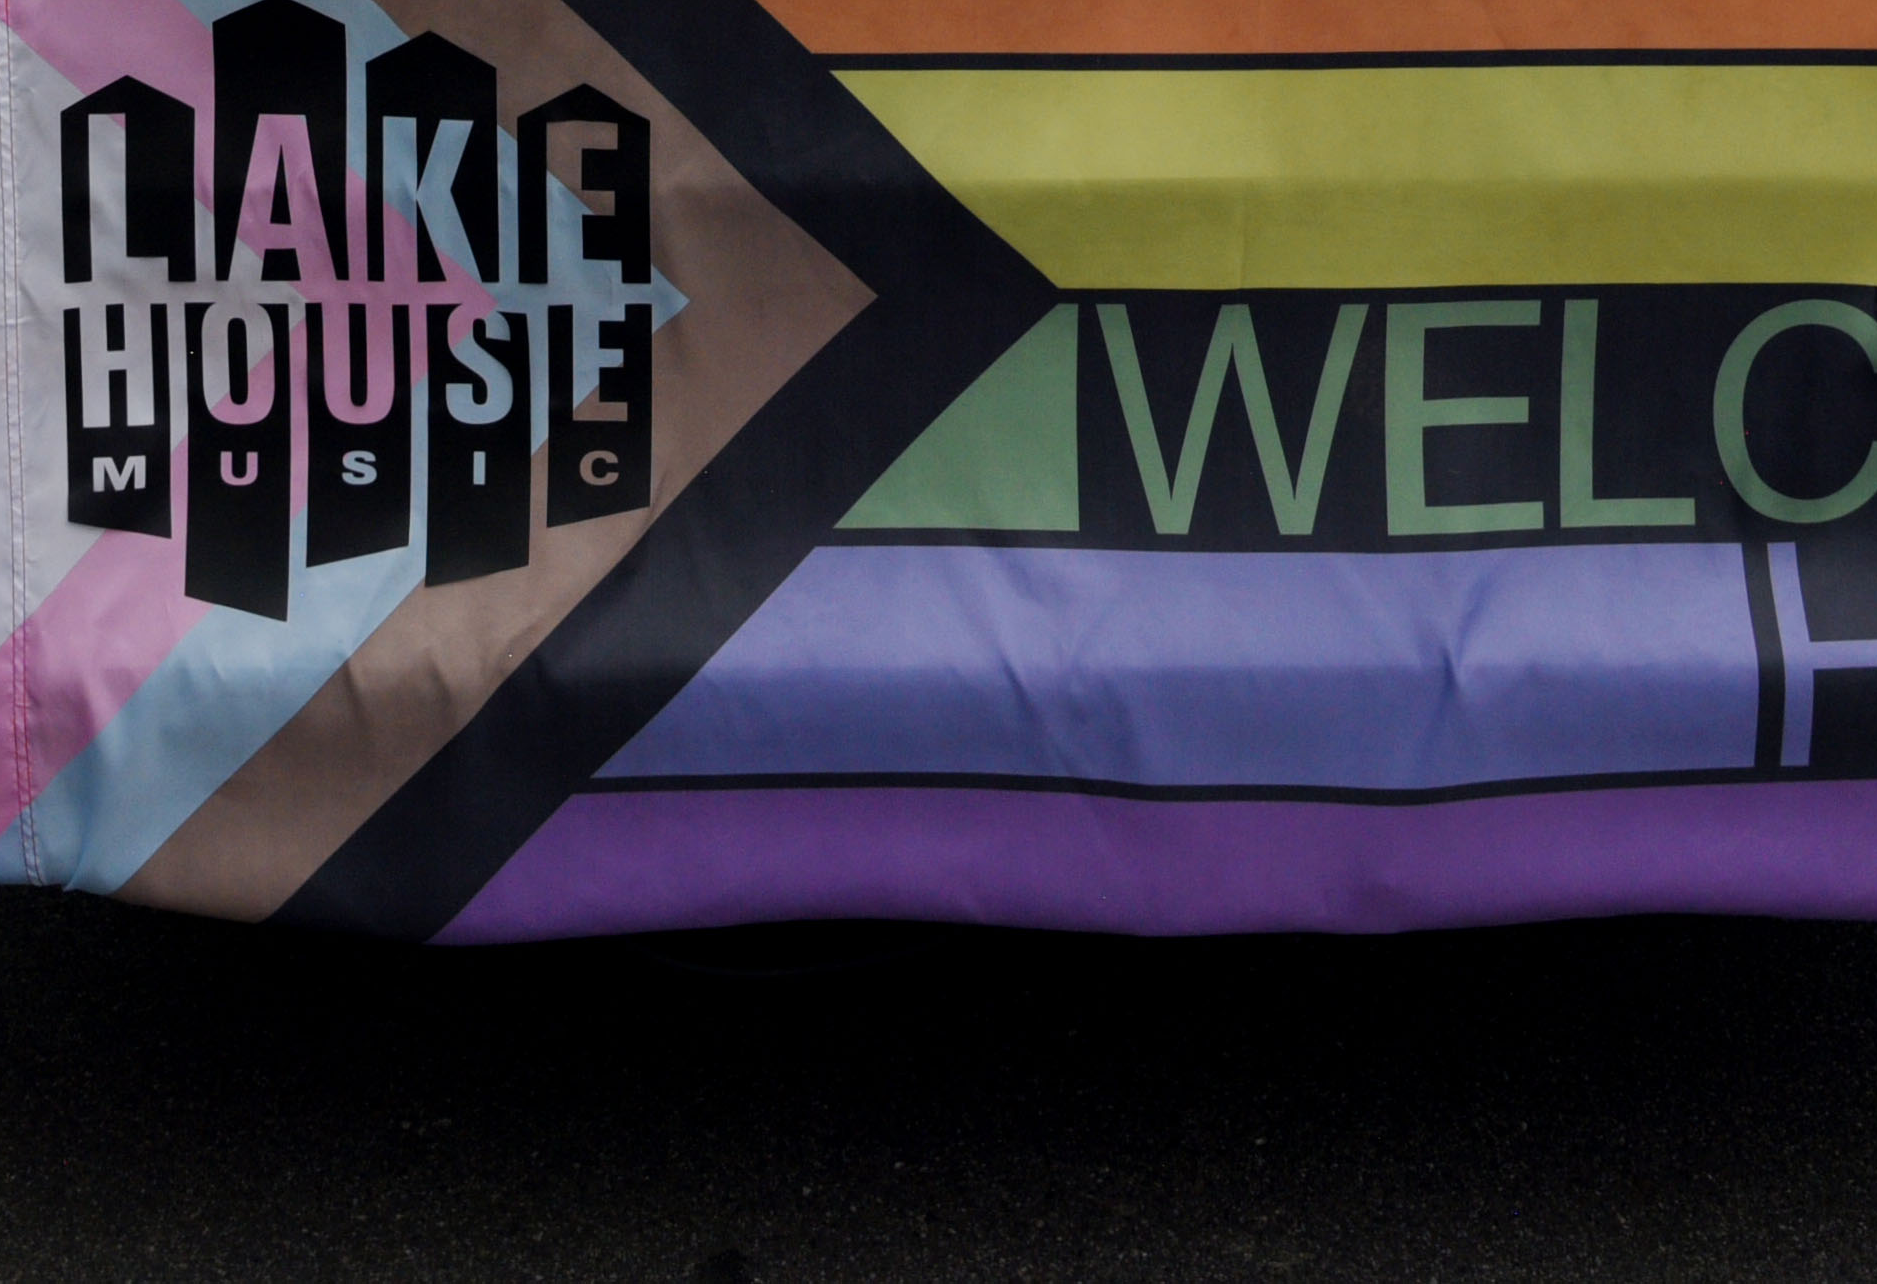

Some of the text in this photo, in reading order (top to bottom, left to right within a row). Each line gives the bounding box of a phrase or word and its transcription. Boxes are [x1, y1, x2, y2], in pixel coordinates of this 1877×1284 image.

[87, 111, 620, 283] LAKE
[80, 300, 630, 429] HOUSE
[91, 449, 621, 491] MUSIC
